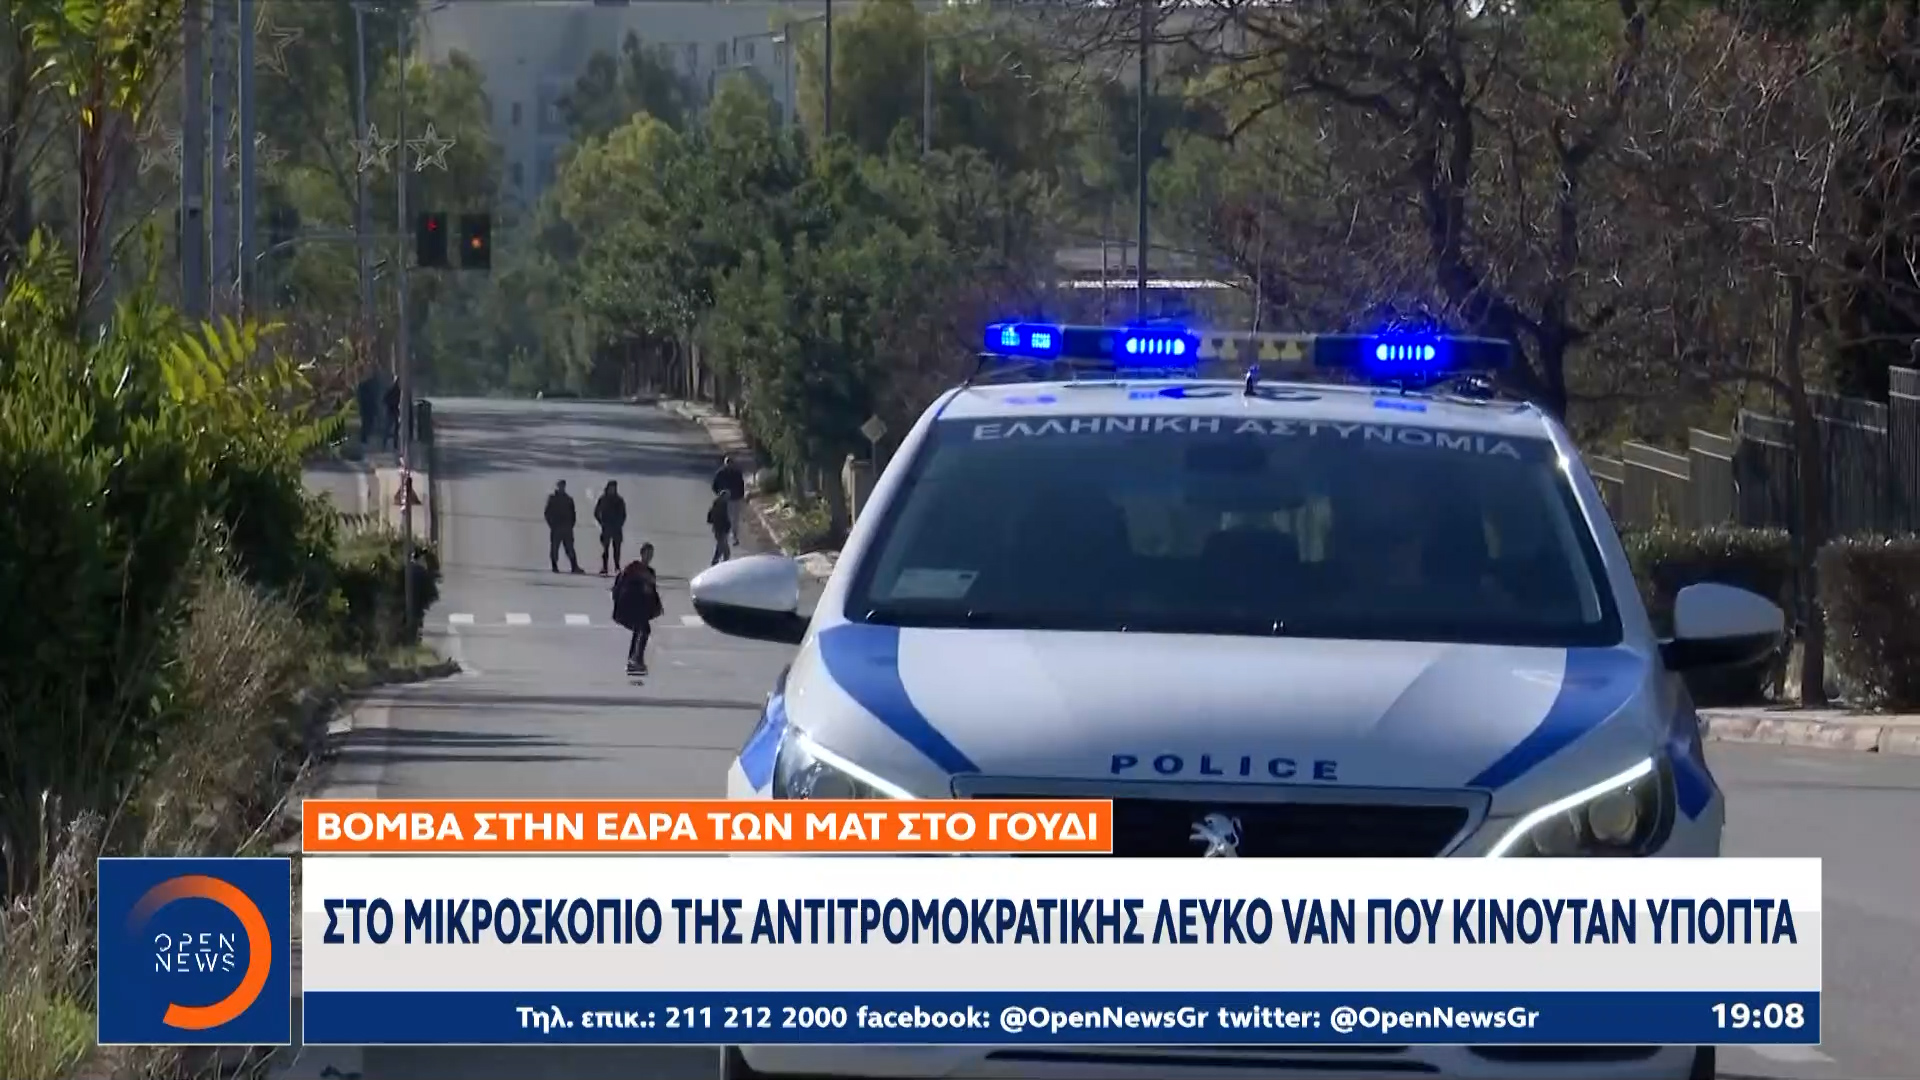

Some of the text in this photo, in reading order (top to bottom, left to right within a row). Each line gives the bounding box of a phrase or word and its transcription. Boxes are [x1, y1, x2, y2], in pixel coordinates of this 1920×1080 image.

[972, 416, 1522, 460] ΕΛΛΗΝΙΚΗ ΑΣΤΥΝΟΜΙΑ
[1110, 753, 1339, 781] POLICE
